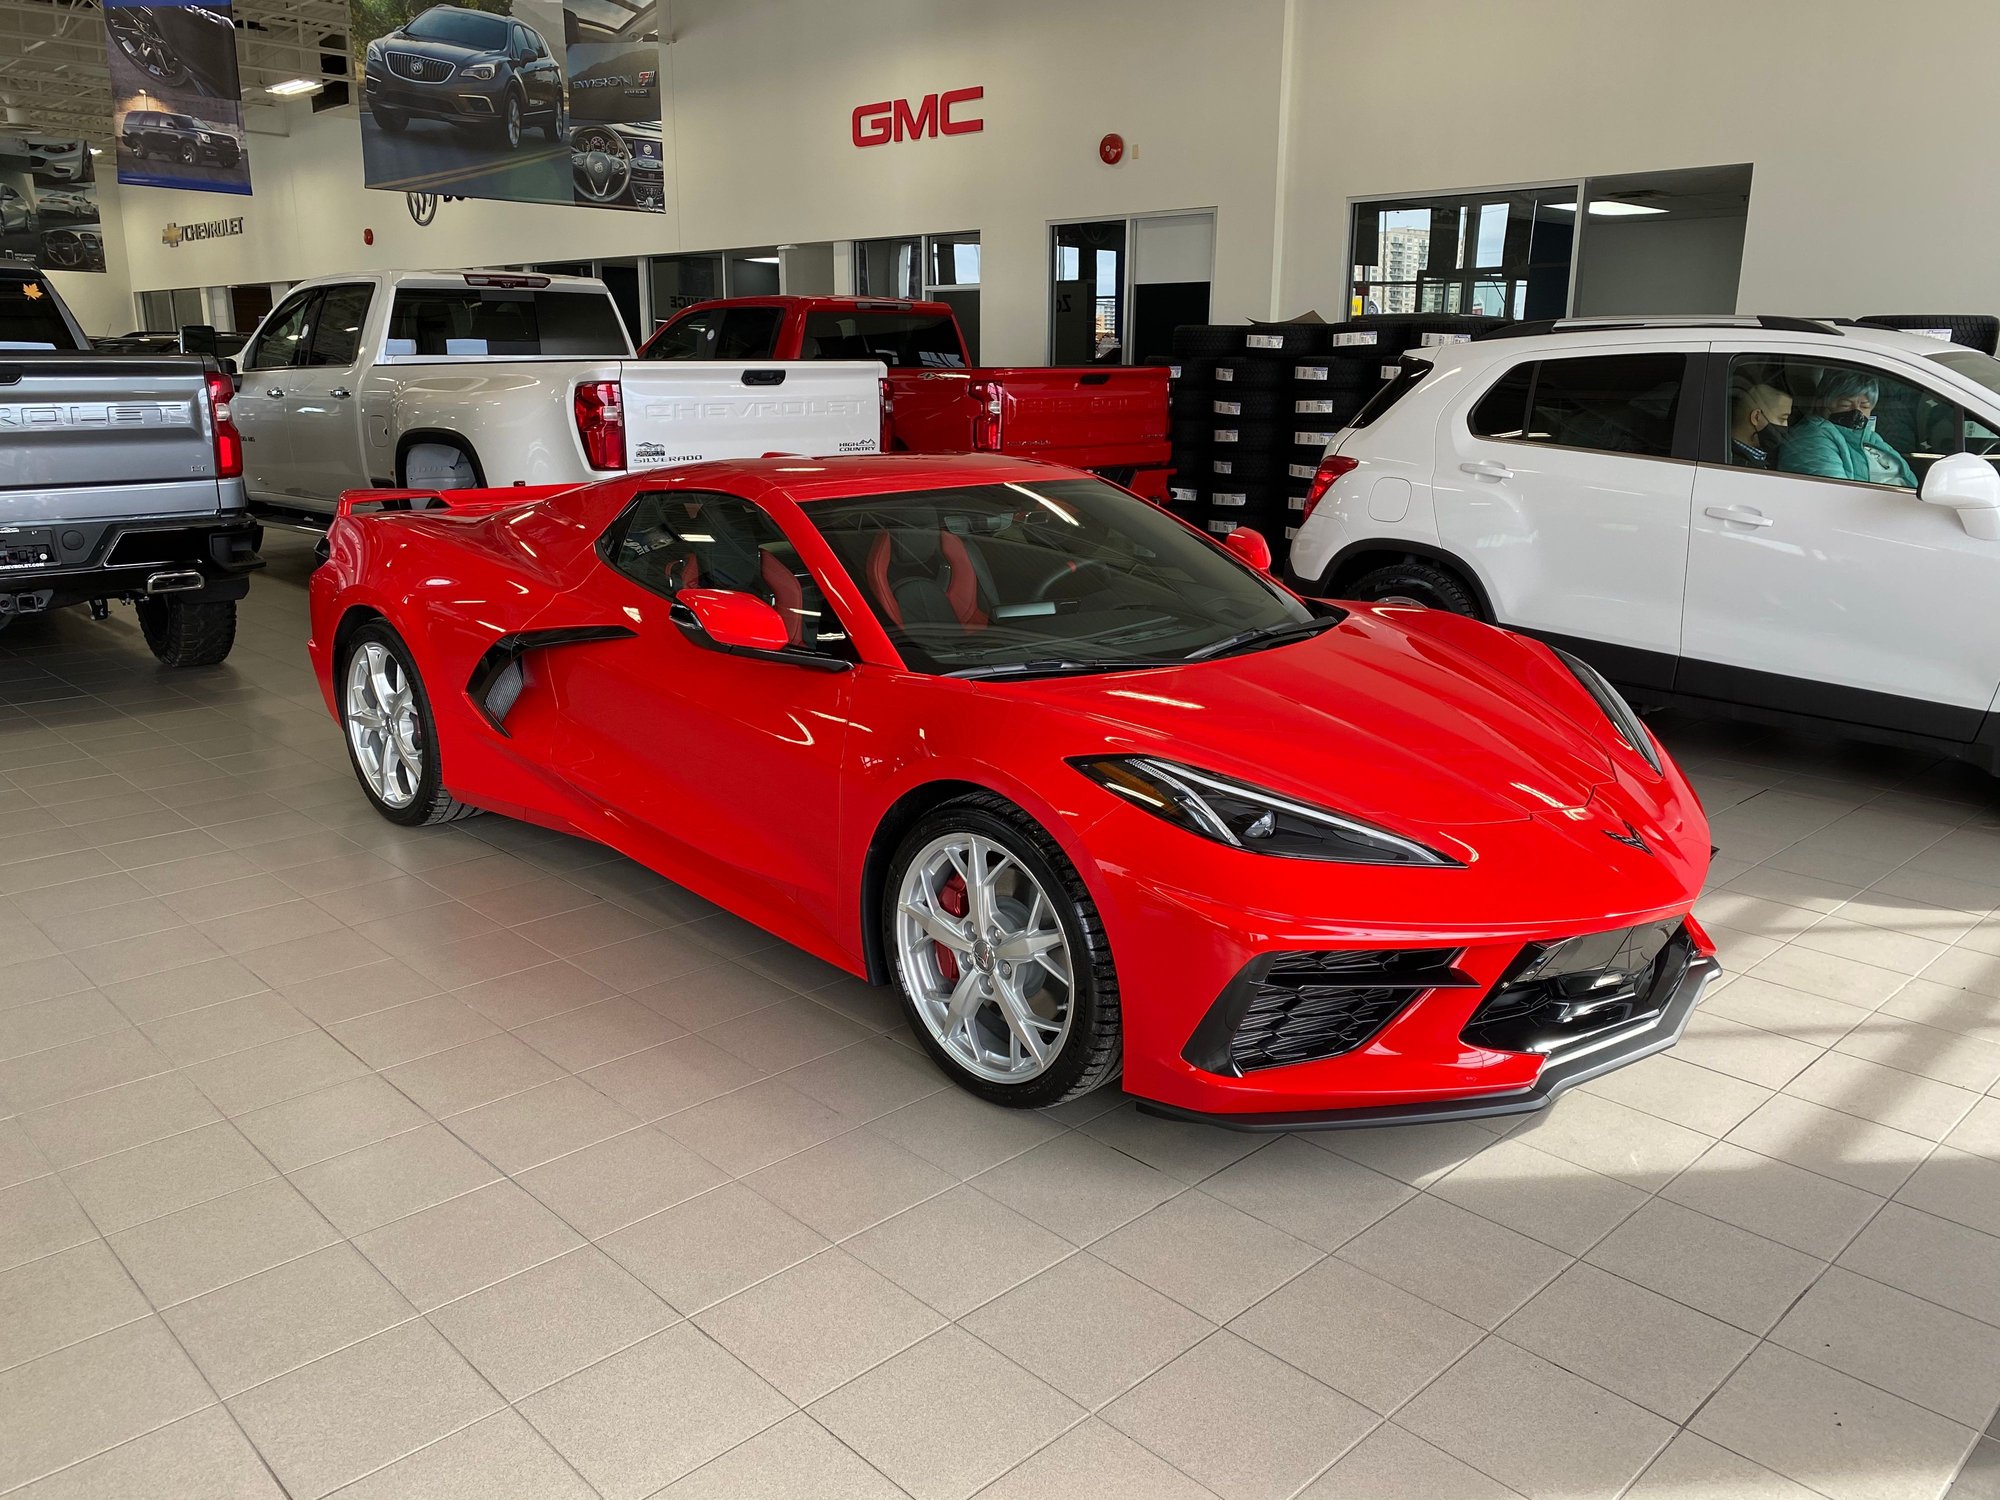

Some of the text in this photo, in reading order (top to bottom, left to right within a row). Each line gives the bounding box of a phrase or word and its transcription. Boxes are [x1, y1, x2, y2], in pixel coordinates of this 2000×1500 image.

[852, 86, 983, 147] GMC
[184, 217, 243, 241] CHEVROLET
[645, 400, 867, 420] CHEVROLET
[634, 454, 703, 464] SILVERADO
